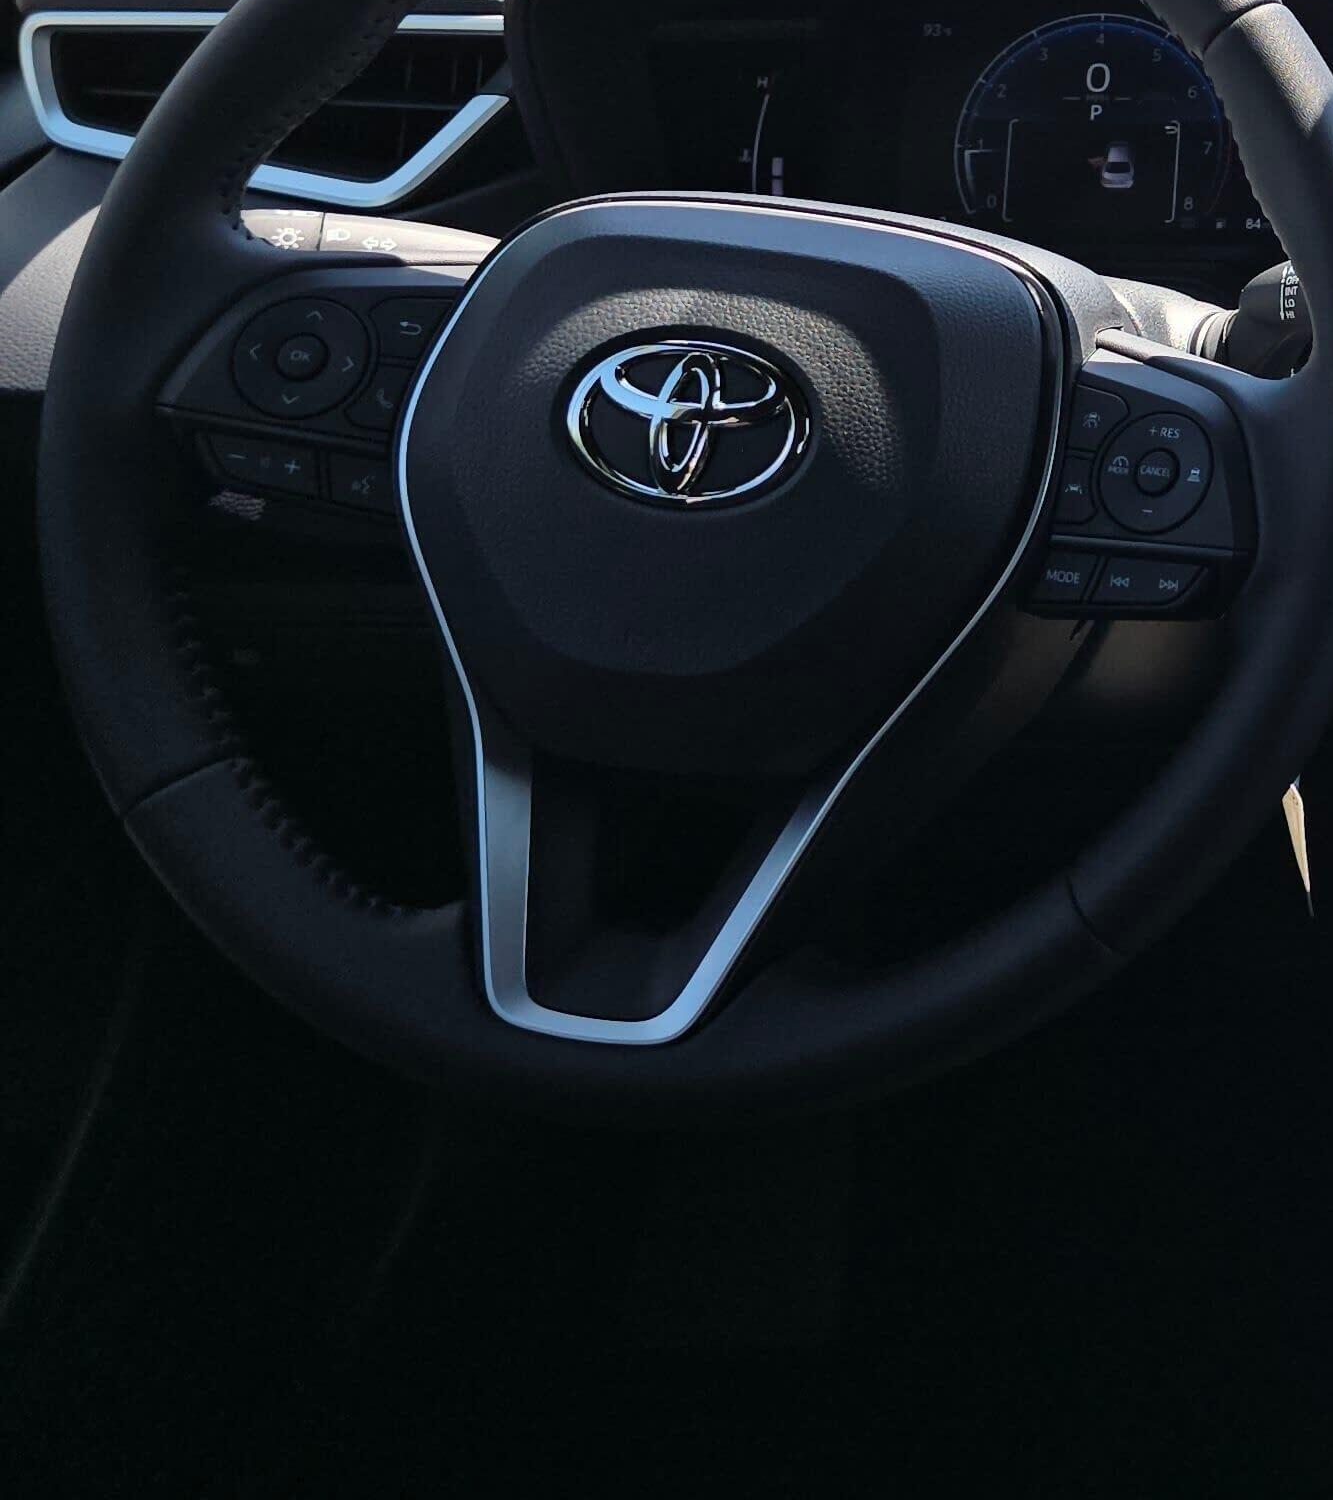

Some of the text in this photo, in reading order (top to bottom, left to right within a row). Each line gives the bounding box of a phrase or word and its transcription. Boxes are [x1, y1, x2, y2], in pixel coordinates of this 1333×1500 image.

[1095, 33, 1105, 45] 4
[1038, 48, 1048, 61] 3
[1152, 48, 1162, 62] 5
[1085, 62, 1111, 93] 0
[997, 84, 1007, 98] 2
[1187, 85, 1198, 99] 6
[1090, 104, 1103, 121] P
[1203, 141, 1213, 155] 7
[1183, 196, 1194, 210] 8
[1285, 286, 1298, 296] INT
[1285, 298, 1295, 308] LO
[288, 349, 312, 364] OK
[1138, 464, 1171, 477] CANCEL
[1045, 569, 1081, 585] MODE
